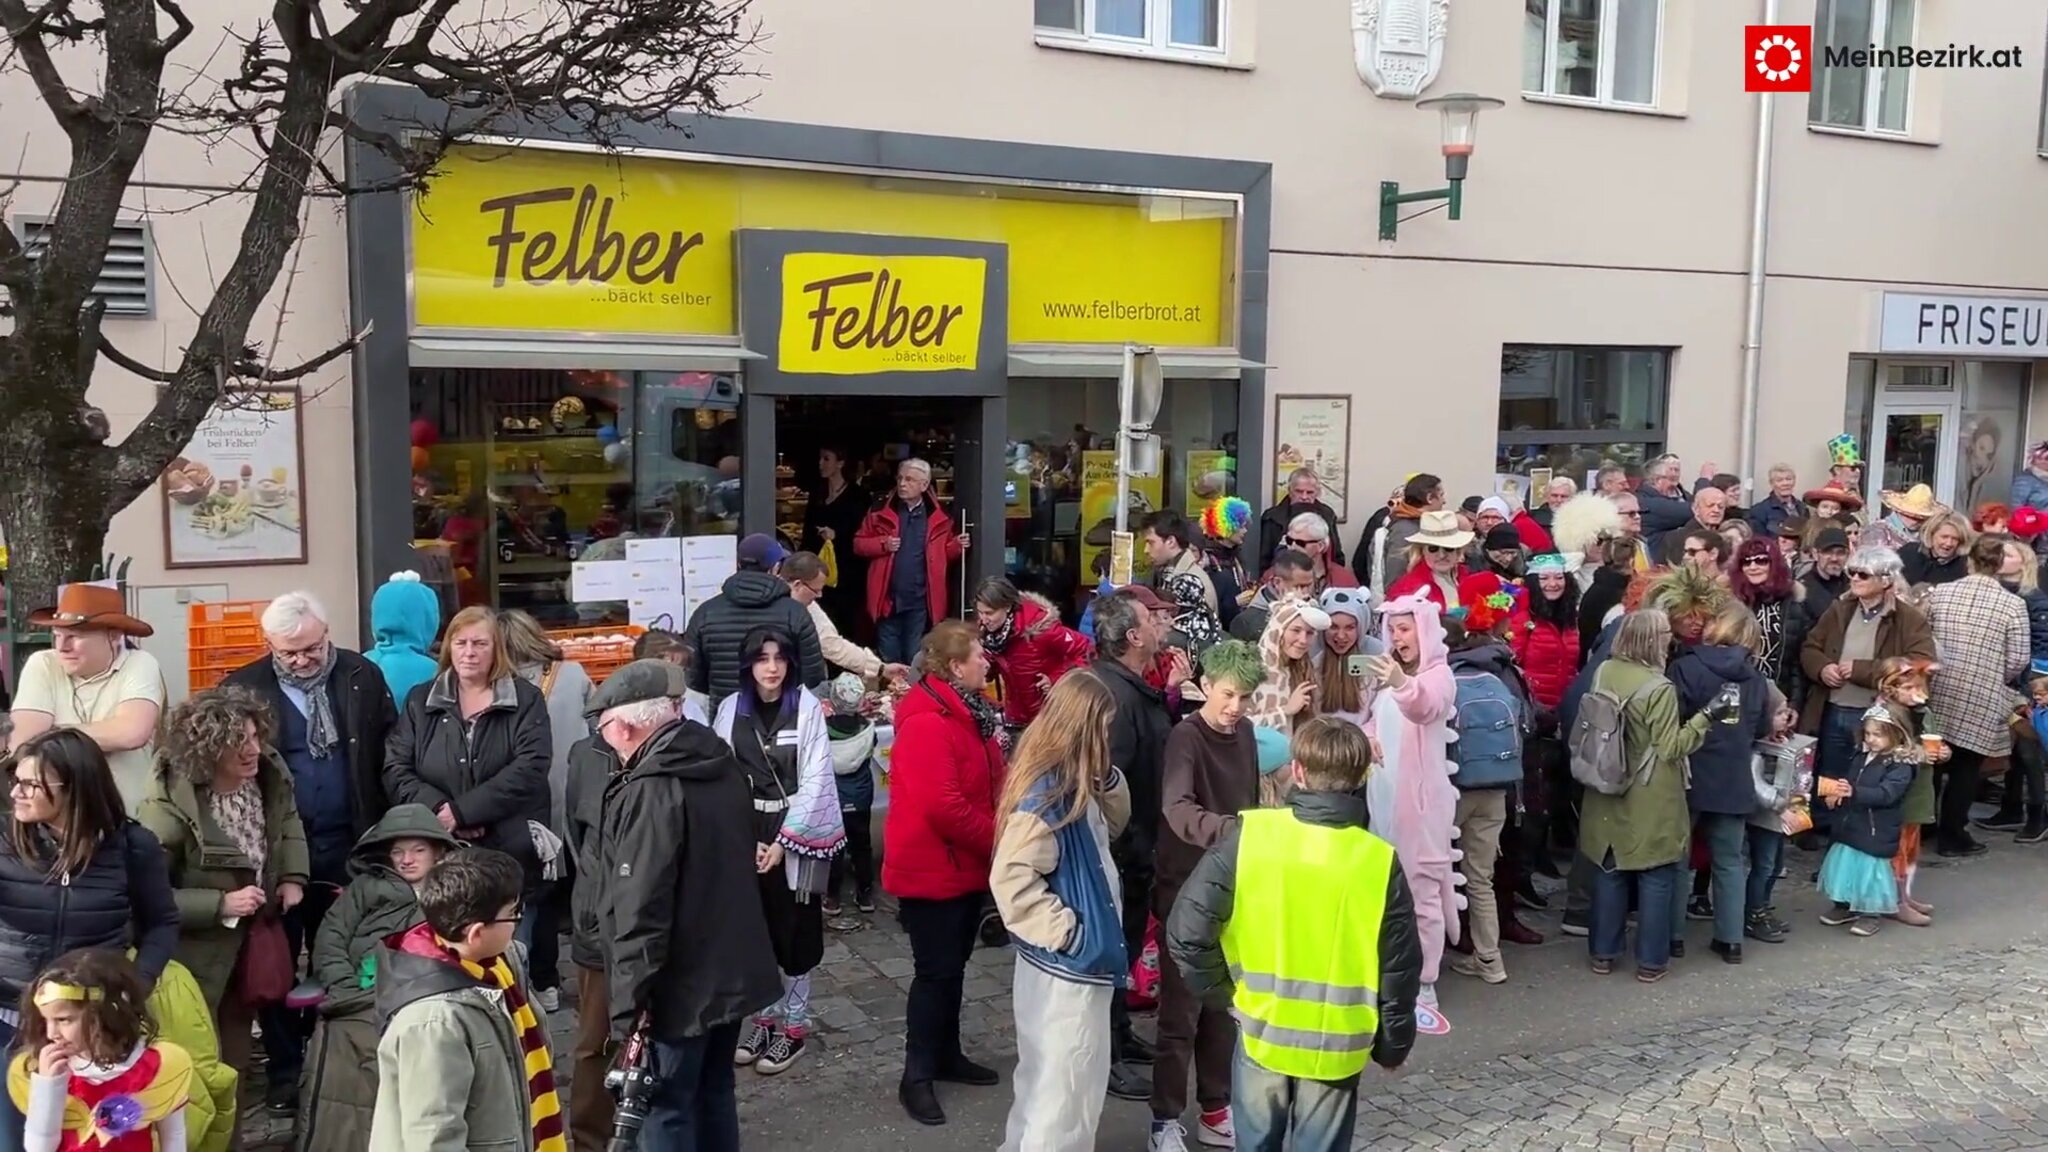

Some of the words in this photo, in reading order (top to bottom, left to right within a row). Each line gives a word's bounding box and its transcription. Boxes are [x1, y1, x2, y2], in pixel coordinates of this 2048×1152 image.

[480, 184, 704, 288] Felber
[661, 291, 712, 306] selber
[803, 268, 963, 351] Felber
[1043, 300, 1201, 322] www.felberbrot.at
[1918, 303, 2048, 347] FRISEU
[932, 352, 967, 364] selber
